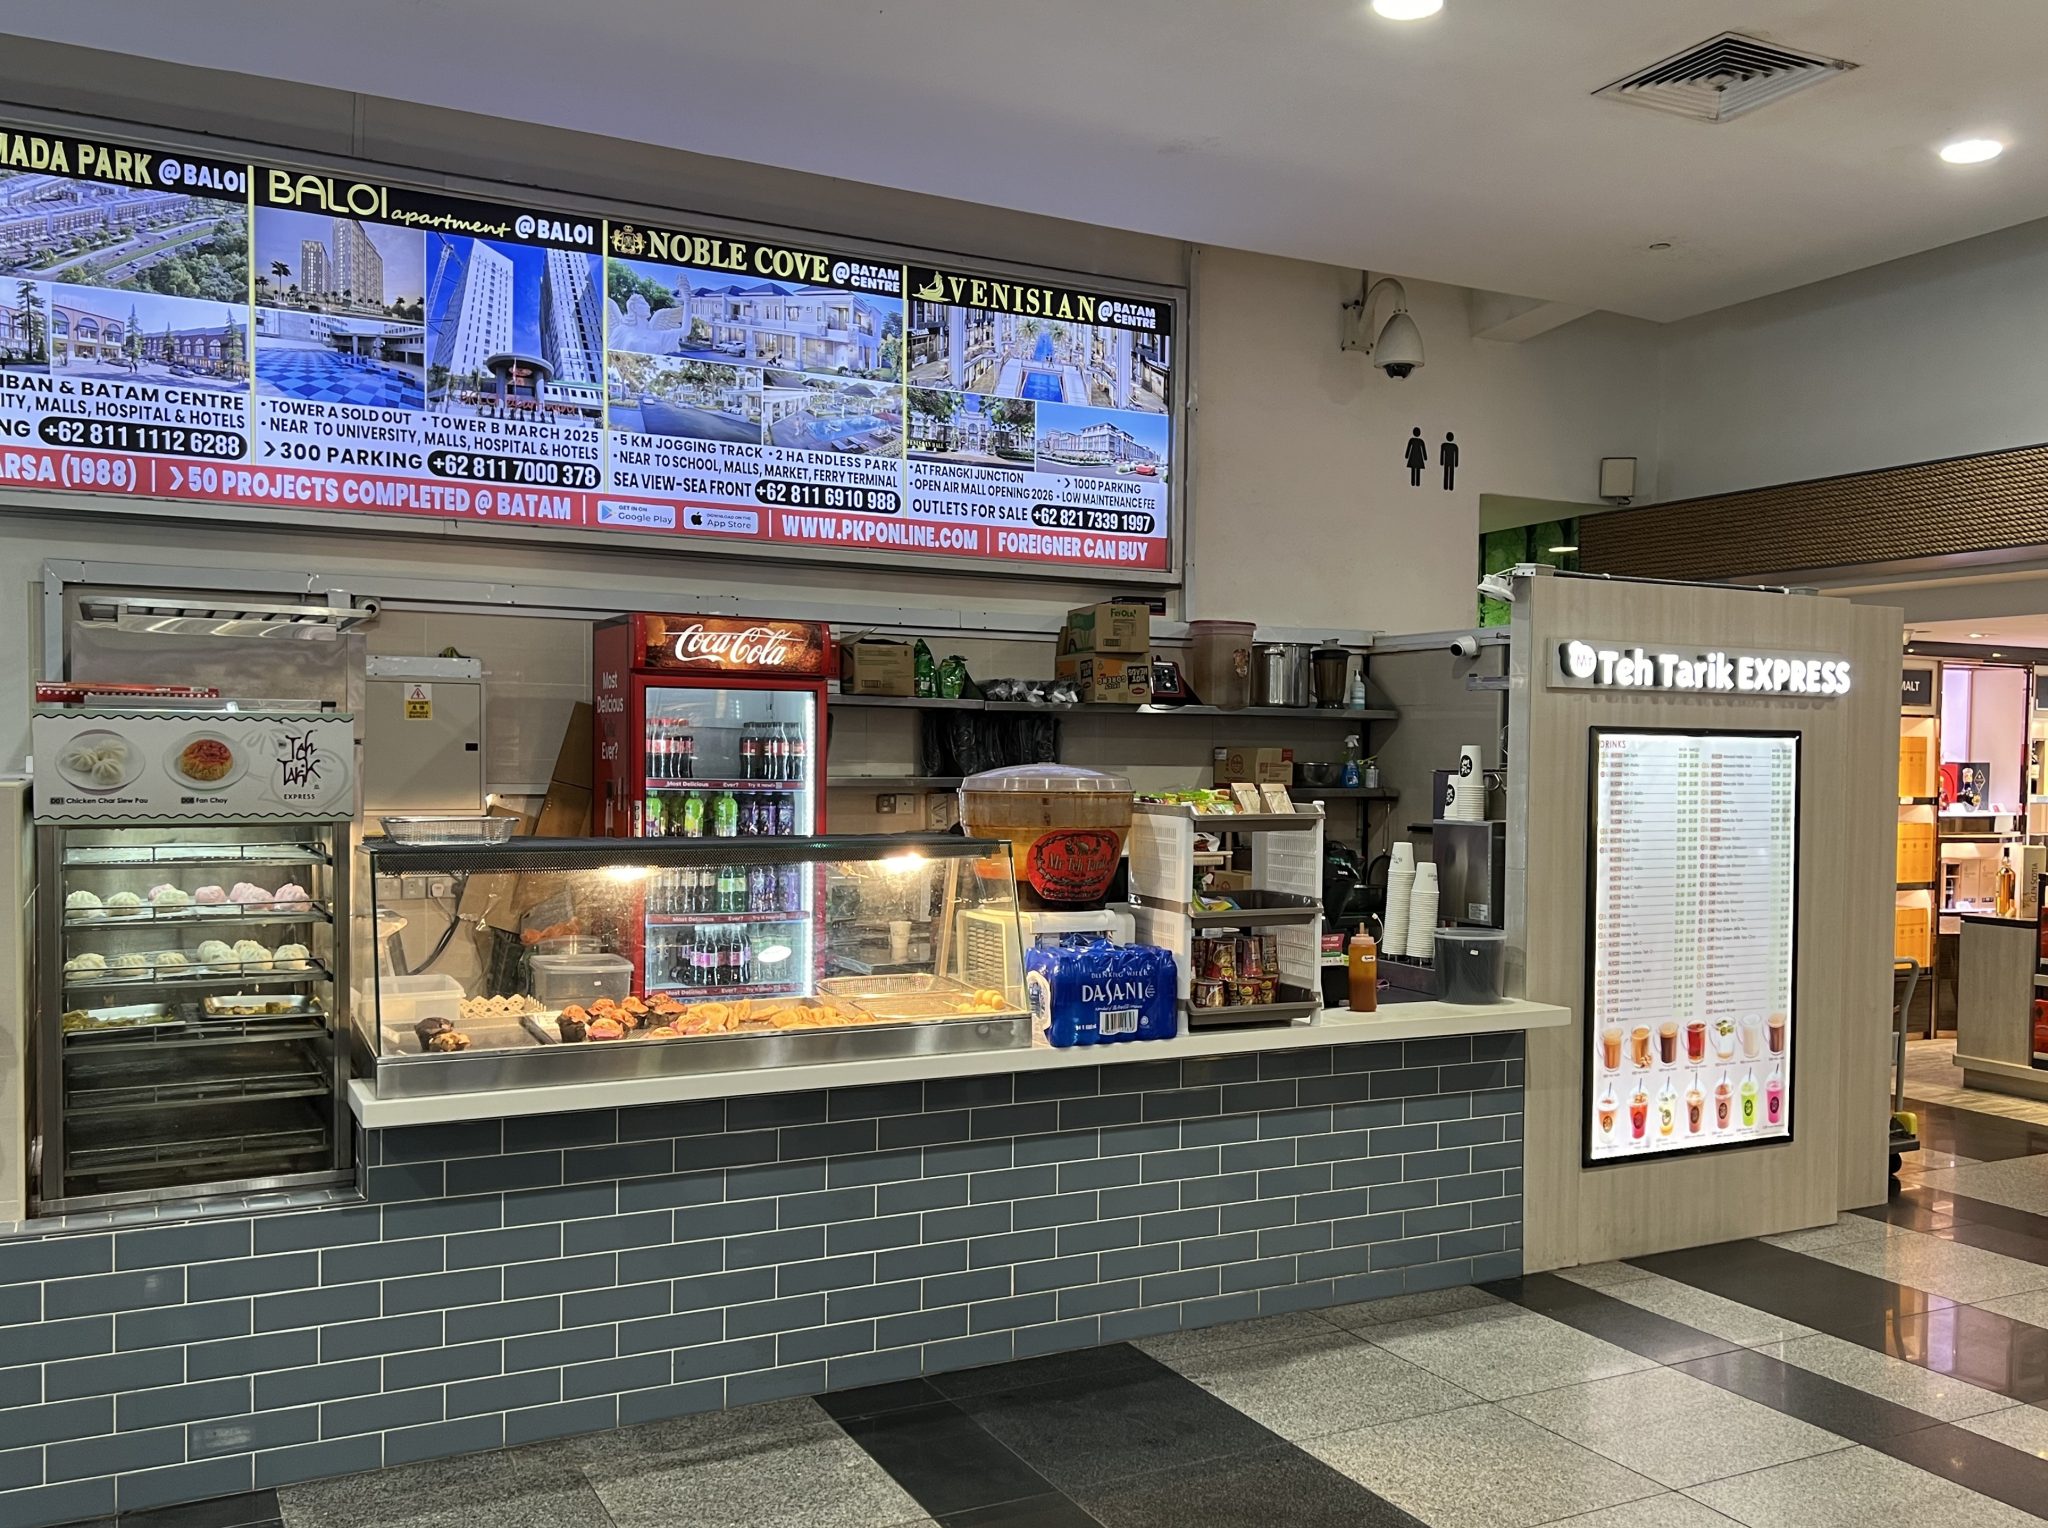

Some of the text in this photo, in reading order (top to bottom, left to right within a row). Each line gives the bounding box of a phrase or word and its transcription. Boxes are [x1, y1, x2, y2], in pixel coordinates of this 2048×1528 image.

[78, 144, 152, 184] PARK
[269, 169, 387, 218] BALOI
[391, 208, 510, 238] apartment
[647, 231, 747, 271] NOBLE
[754, 247, 830, 283] COVE
[851, 275, 900, 293] CENTRE
[948, 276, 1096, 322] VENISIAN
[1113, 314, 1156, 329] CENTRE
[59, 381, 75, 394] &
[81, 382, 159, 402] BATAM
[165, 390, 243, 410] CENTRE
[36, 397, 92, 418] MALLS,
[96, 401, 171, 422] HOSPITAL
[176, 410, 186, 424] &
[190, 411, 245, 429] HOTELS
[270, 401, 411, 425] TOWER A SOLD OUT
[44, 421, 84, 443] +62
[90, 424, 127, 446] 811
[136, 427, 185, 451] 1112
[190, 432, 240, 456] 6288
[270, 417, 599, 461] NEAR TO UNIVERSITY, MALLS, HOSPITAL & HOTELS
[431, 416, 599, 443] TOWER B MARCH 2025
[620, 434, 763, 459] 5 KM JOGGING TRACK
[775, 449, 897, 472] 2 HA ENDLESS PARK
[0, 452, 137, 492] RSA (1988)
[327, 447, 422, 470] PARKING
[432, 454, 468, 476] +62
[473, 458, 507, 479] 811
[512, 460, 558, 483] 7000
[562, 465, 596, 486] 378
[620, 451, 651, 466] NEAR
[655, 454, 670, 467] TO
[813, 469, 845, 484] FERRY
[846, 472, 898, 488] TERMINAL
[914, 463, 1024, 484] AT FRANGKI JUNCTION
[222, 470, 338, 502] PROJECTS
[344, 480, 470, 512] COMPLETED
[474, 490, 493, 515] @
[497, 492, 571, 520] BATAM
[614, 471, 638, 489] SEA
[710, 481, 752, 498] FRONT
[756, 485, 786, 502] +62
[790, 487, 819, 505] 811
[824, 489, 864, 508] 6910
[867, 491, 896, 511] 988
[914, 479, 1054, 501] OPEN AIR MALL OPENING 2026
[1062, 491, 1156, 510] LOW MAINTENANCE FEE
[1074, 478, 1141, 494] 1000 PARKING
[618, 512, 673, 525] Google Play
[707, 519, 752, 529] App Store
[912, 498, 1151, 532] OUTLETS FOR SALE +62 821 7339 1997
[782, 515, 978, 550] WWW.PKPONLINE.COM
[998, 531, 1148, 561] FOREIGNER CAN BUY
[602, 671, 618, 690] Most
[1598, 648, 1653, 687] Teh
[1658, 652, 1735, 690] Tarik
[1738, 656, 1851, 695] EXPRESS
[596, 693, 624, 713] Delicious
[601, 742, 619, 760] Ever?
[1082, 979, 1143, 1005] DASANI
